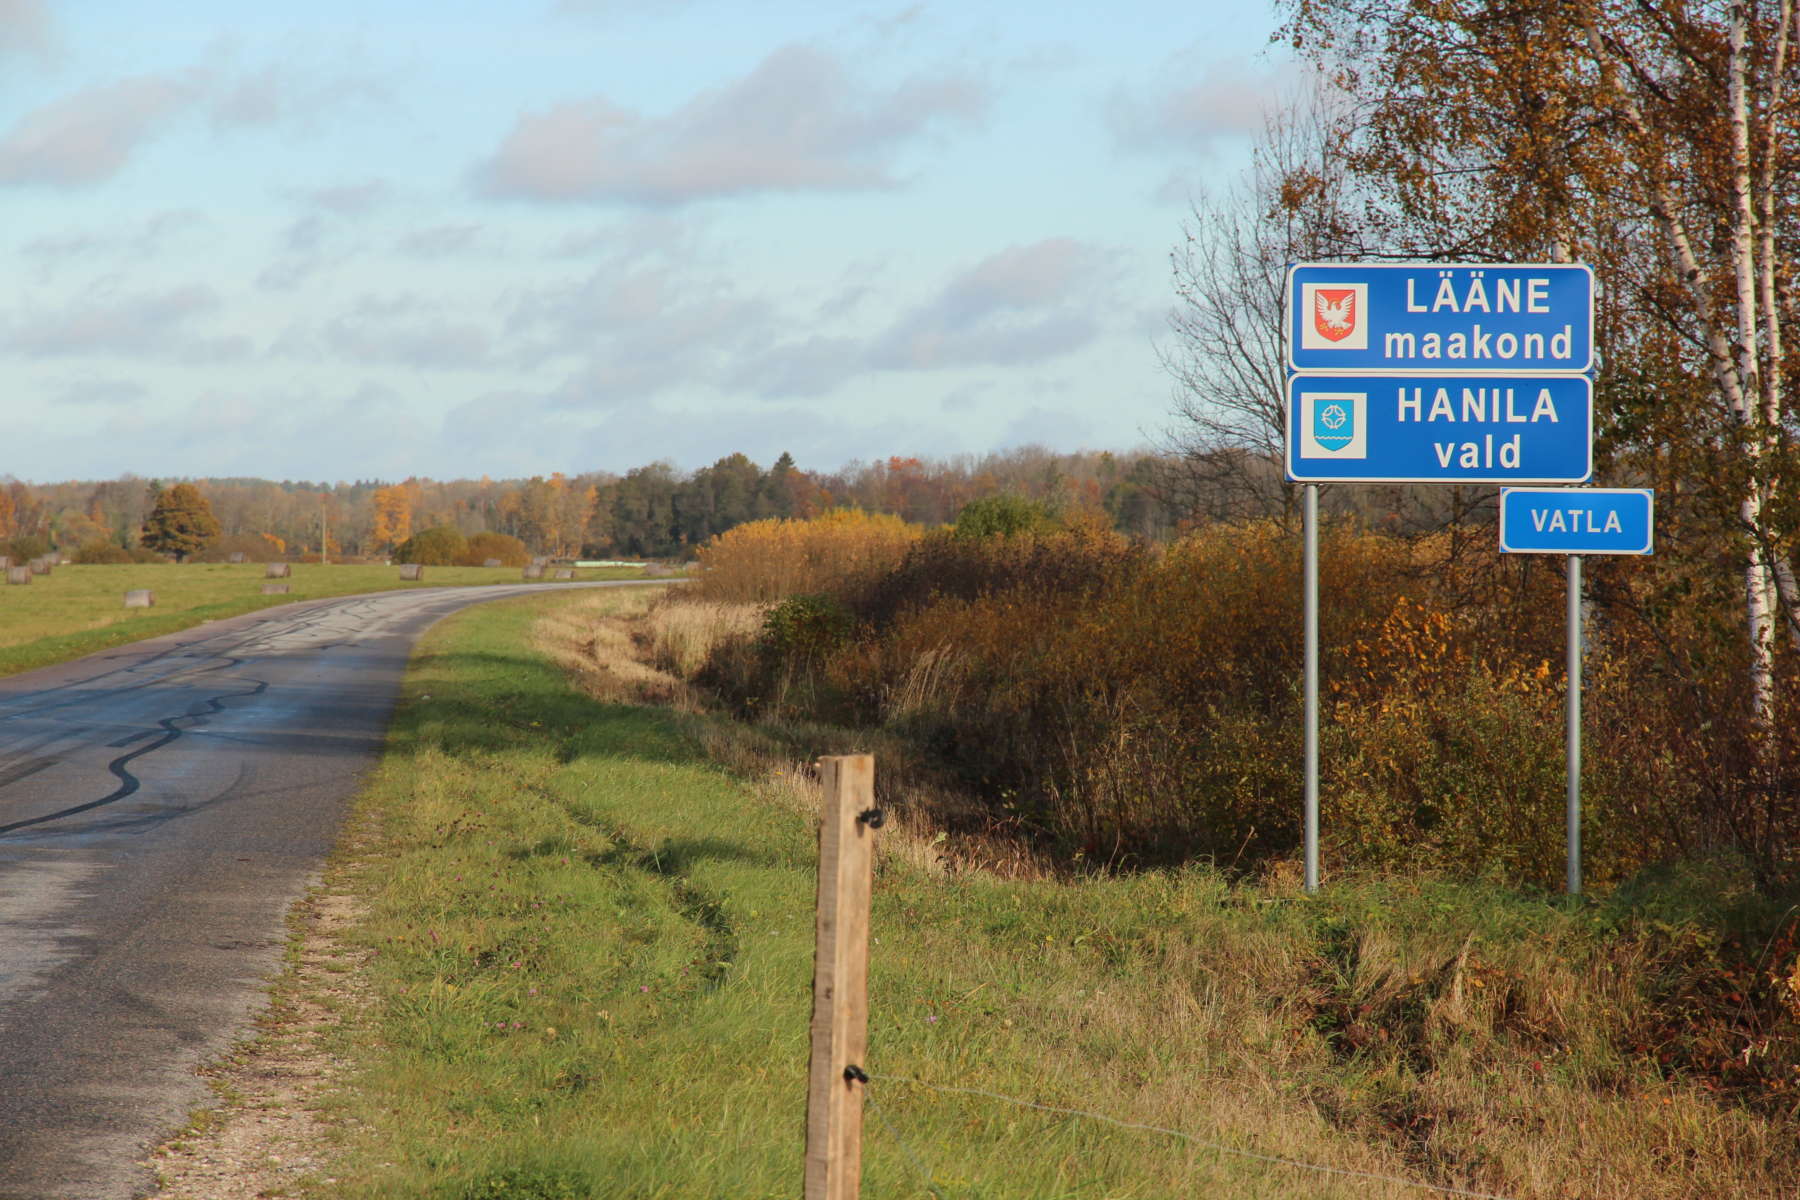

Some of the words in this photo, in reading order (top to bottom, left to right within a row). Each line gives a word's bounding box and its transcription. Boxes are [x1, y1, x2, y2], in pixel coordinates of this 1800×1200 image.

[1406, 271, 1550, 313] LÄÄNE
[1385, 325, 1572, 359] maakond
[1398, 387, 1559, 422] HANILA
[1434, 434, 1521, 468] vald
[1531, 509, 1623, 533] VATLA
